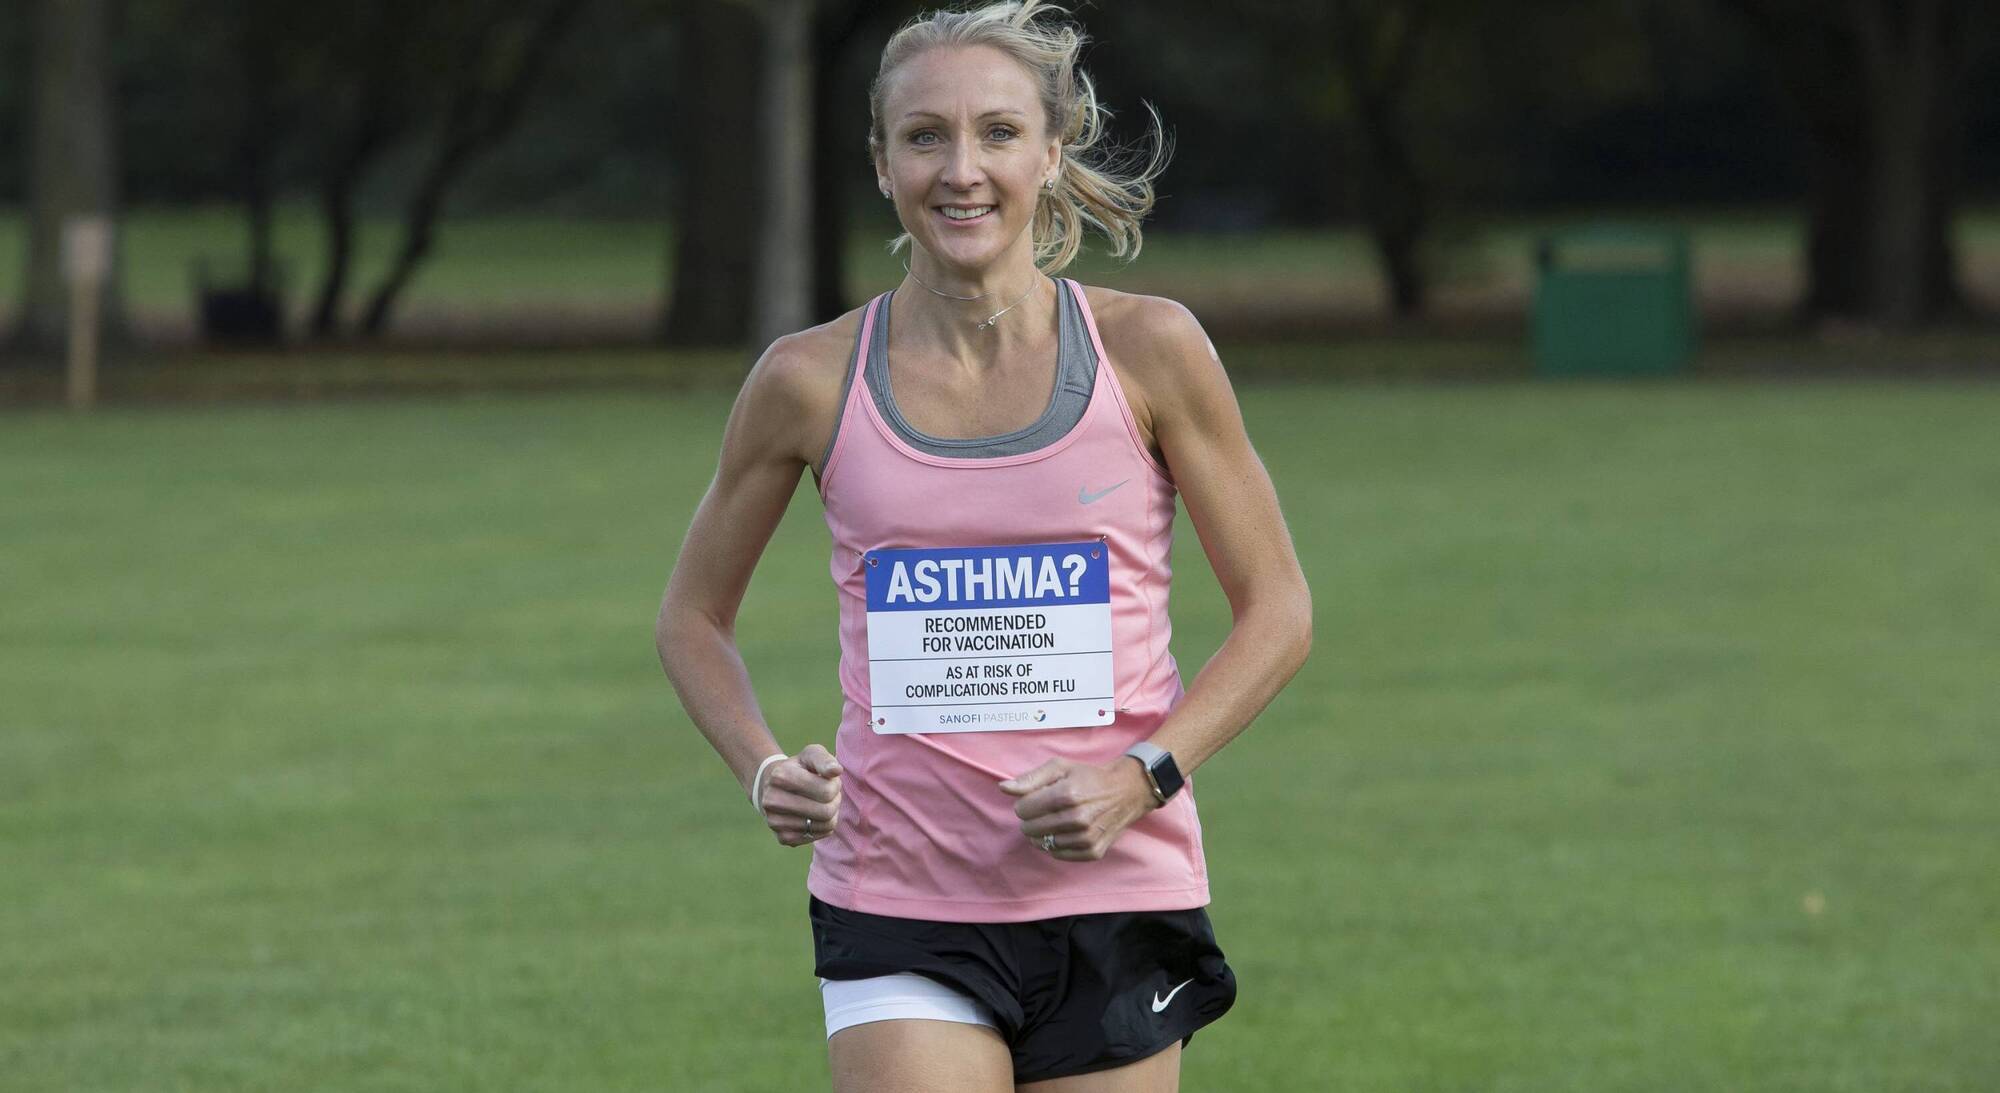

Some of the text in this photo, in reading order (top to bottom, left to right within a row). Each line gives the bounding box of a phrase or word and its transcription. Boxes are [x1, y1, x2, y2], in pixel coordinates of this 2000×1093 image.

[886, 554, 1088, 604] ASTHMA?
[925, 614, 1046, 633] RECOMMENDED
[922, 633, 1055, 653] FOR VACCINATION
[946, 663, 1033, 680] AS AT RISK OF
[905, 679, 1076, 698] COMPLICATIONS FROM FLU
[939, 712, 1029, 725] SANOFI PASTEUR
